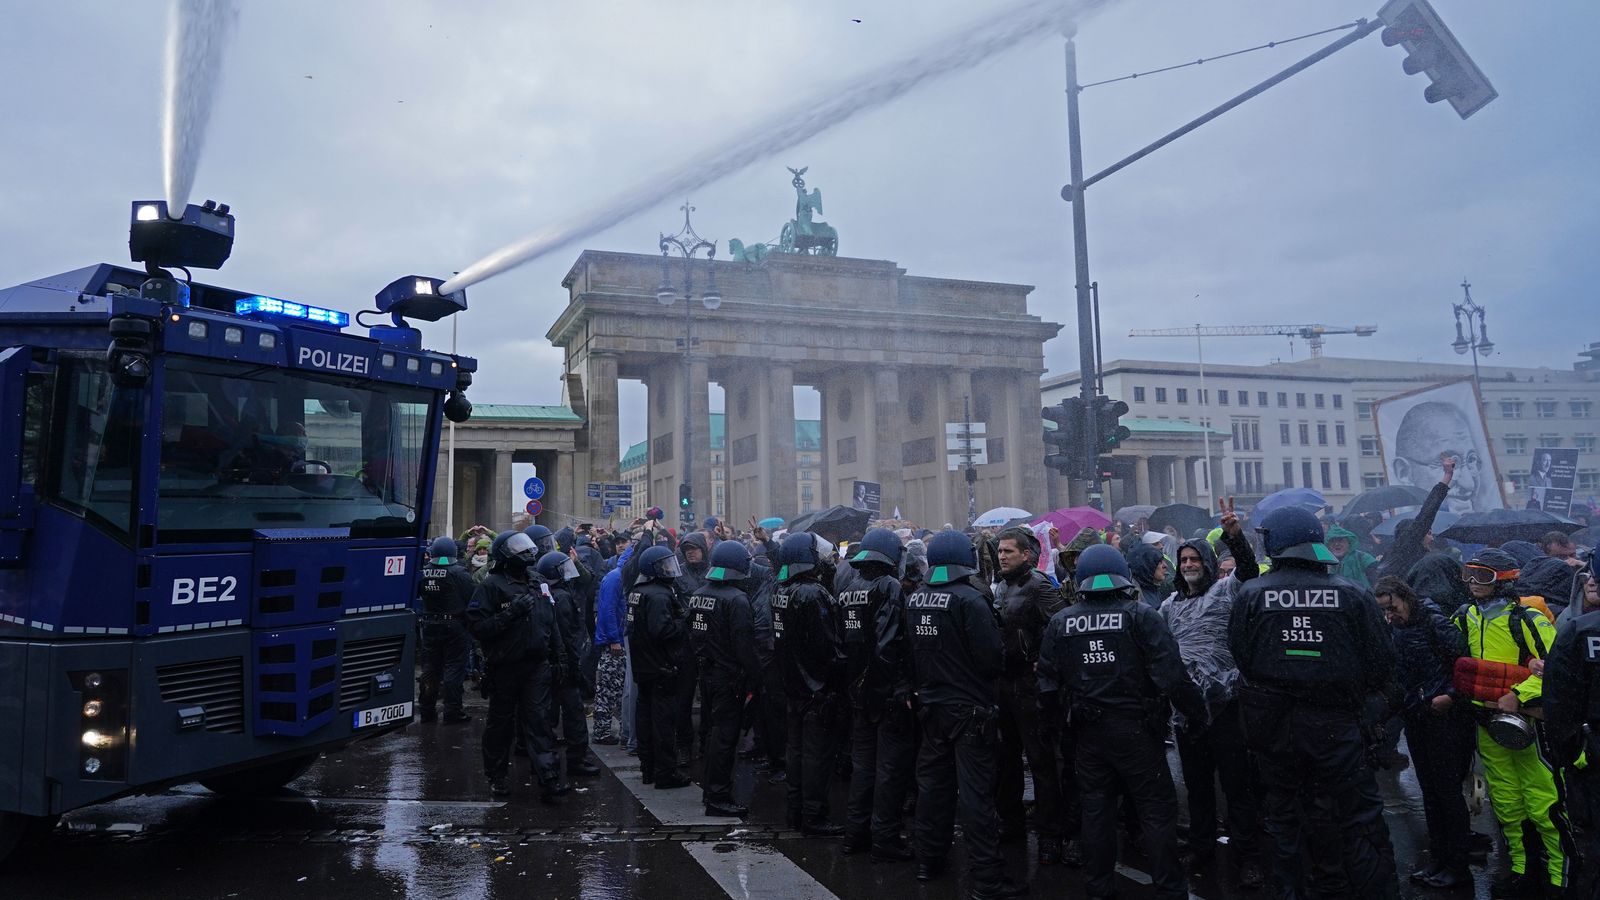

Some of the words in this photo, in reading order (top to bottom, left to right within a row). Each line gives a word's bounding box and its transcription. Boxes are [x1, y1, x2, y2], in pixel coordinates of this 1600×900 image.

[298, 346, 369, 374] POLIZEI
[423, 569, 447, 578] OLIZEI
[171, 575, 237, 605] BE2
[688, 596, 716, 610] POLIZEI
[838, 590, 869, 606] POLIZEI
[908, 592, 951, 608] POLIZEI
[1264, 589, 1339, 608] POLIZEI
[696, 613, 704, 622] BE
[848, 610, 856, 619] BE
[921, 615, 931, 625] BE
[1065, 613, 1123, 634] POLIZEI
[1292, 616, 1311, 628] BE
[915, 625, 938, 636] 35326
[1281, 629, 1324, 642] 35115
[1089, 640, 1104, 651] BE
[1587, 636, 1600, 658] P
[1082, 651, 1116, 664] 35336
[365, 711, 372, 724] B
[381, 705, 405, 721] 7000
